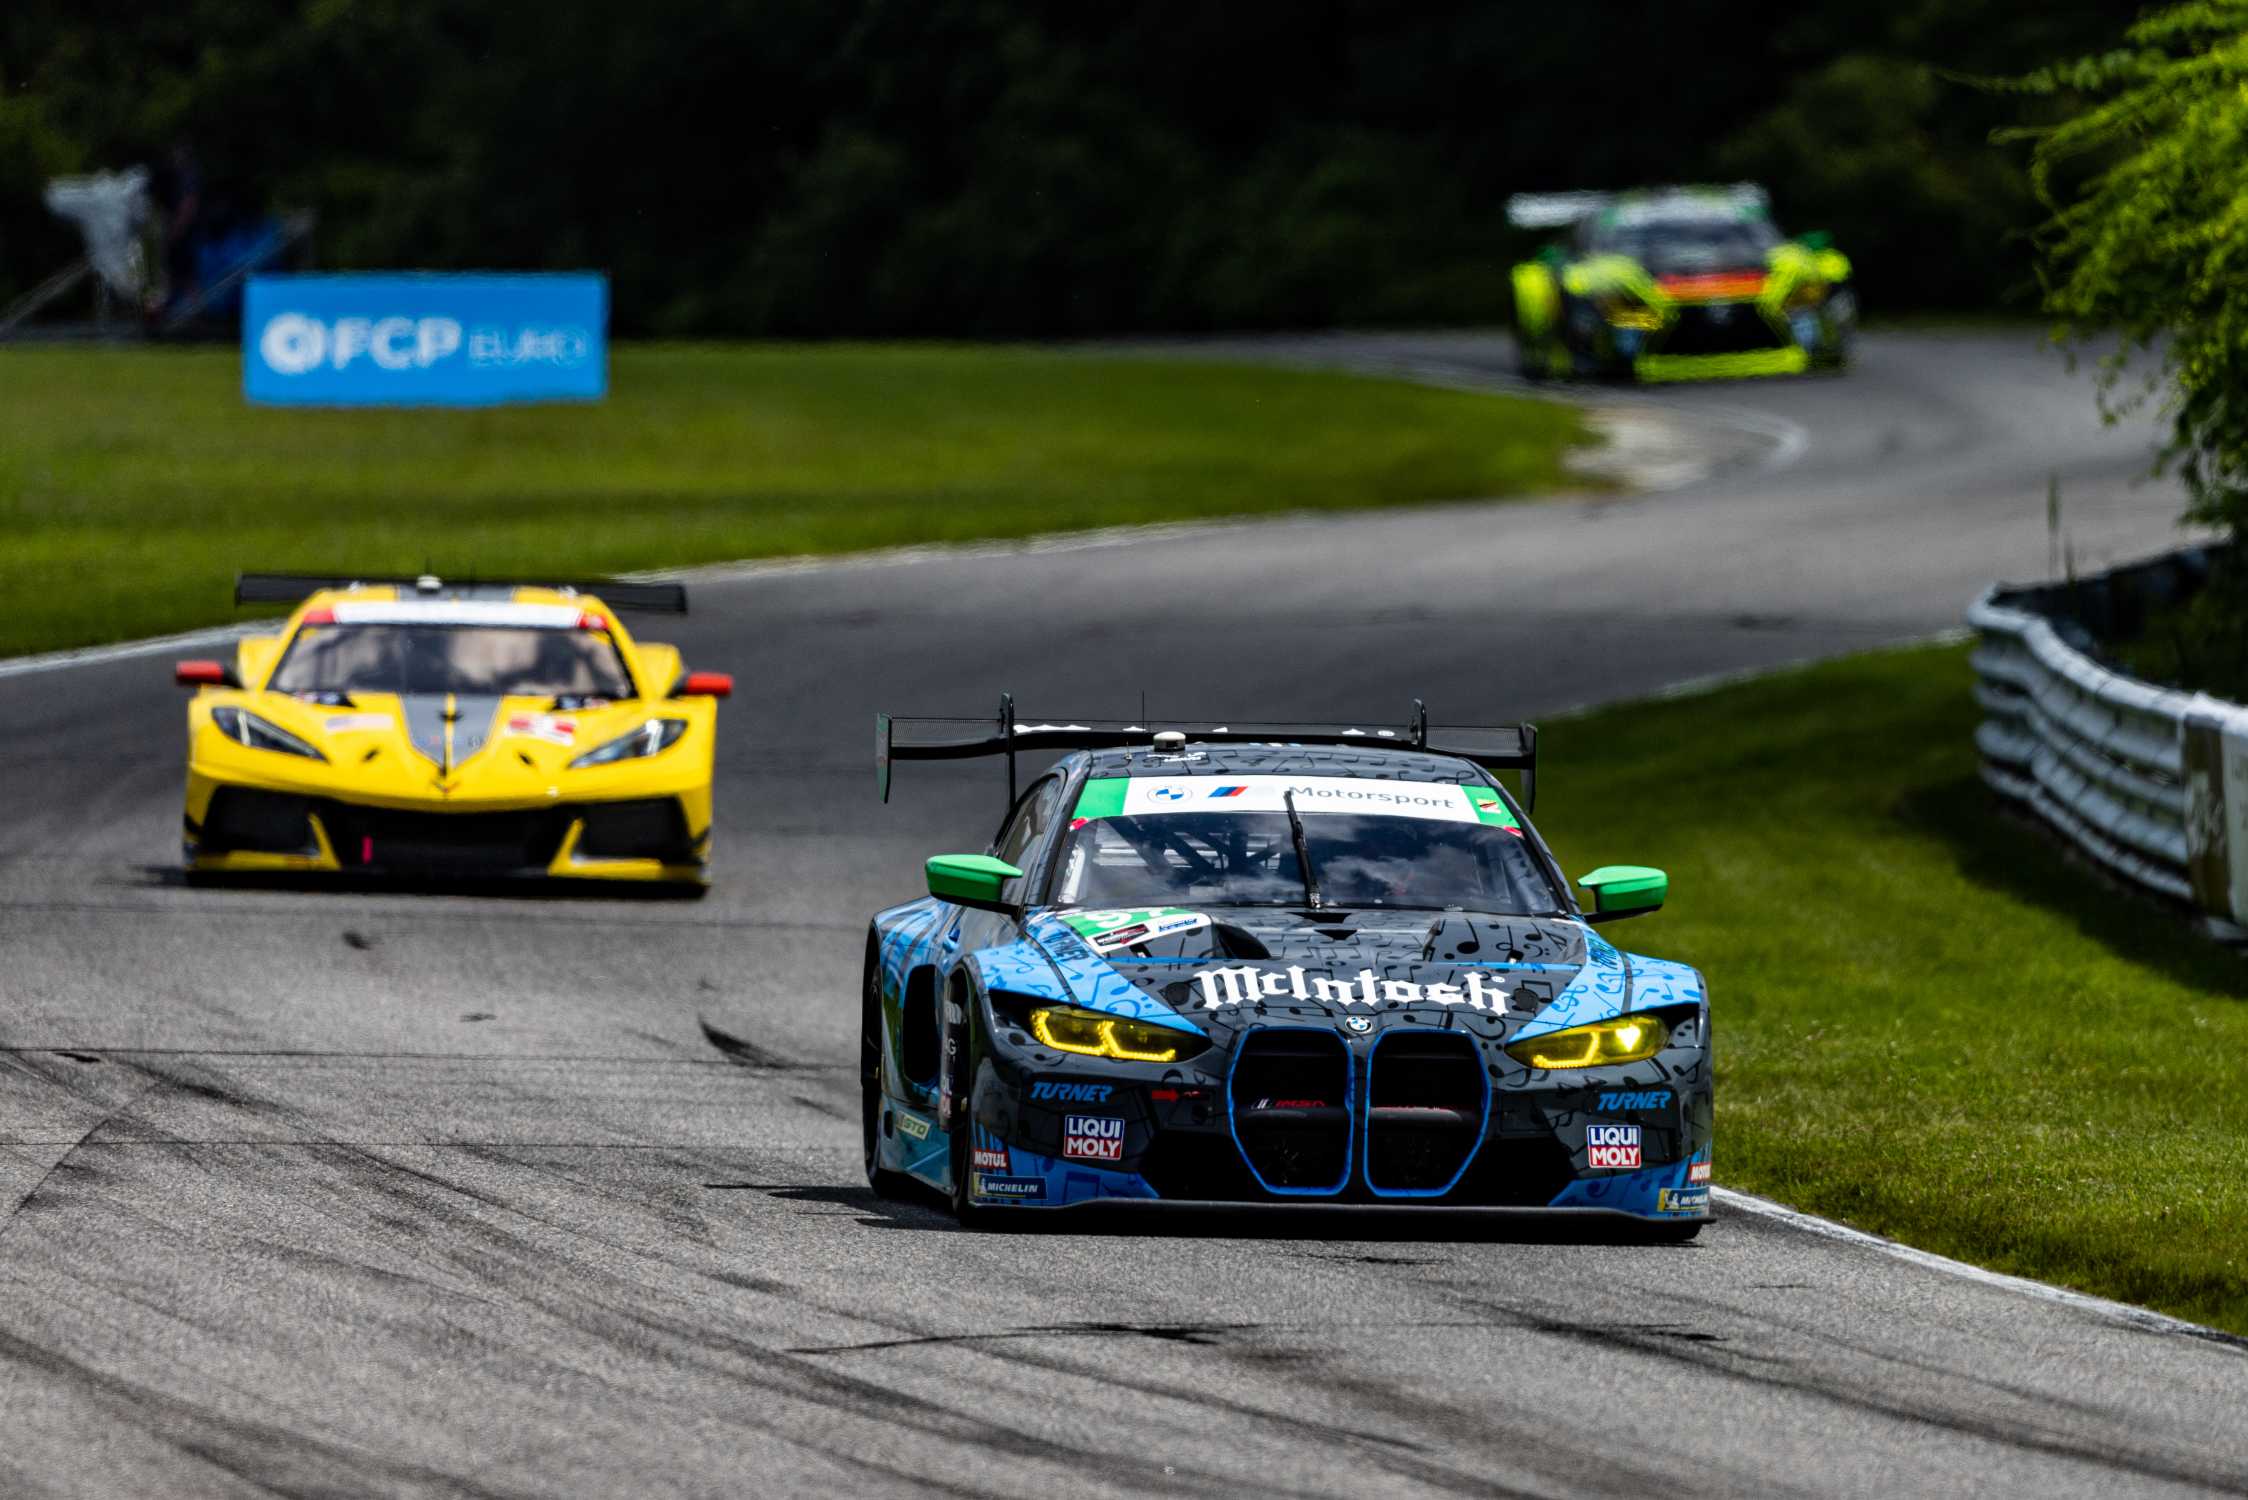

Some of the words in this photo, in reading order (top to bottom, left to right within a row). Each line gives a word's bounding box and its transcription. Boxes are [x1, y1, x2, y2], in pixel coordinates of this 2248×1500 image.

[332, 316, 463, 370] FCP
[1289, 786, 1454, 809] Motorsport
[1194, 965, 1511, 1016] McIntosh
[1029, 1081, 1113, 1102] TURNER
[1597, 1090, 1672, 1111] TURNER
[1068, 1118, 1121, 1138] LIQUI
[1590, 1127, 1638, 1146] LIQUI
[1066, 1137, 1120, 1157] MOLY
[1591, 1147, 1639, 1166] MOLY
[974, 1150, 1007, 1168] MOTUL
[987, 1182, 1039, 1193] MICHELIN
